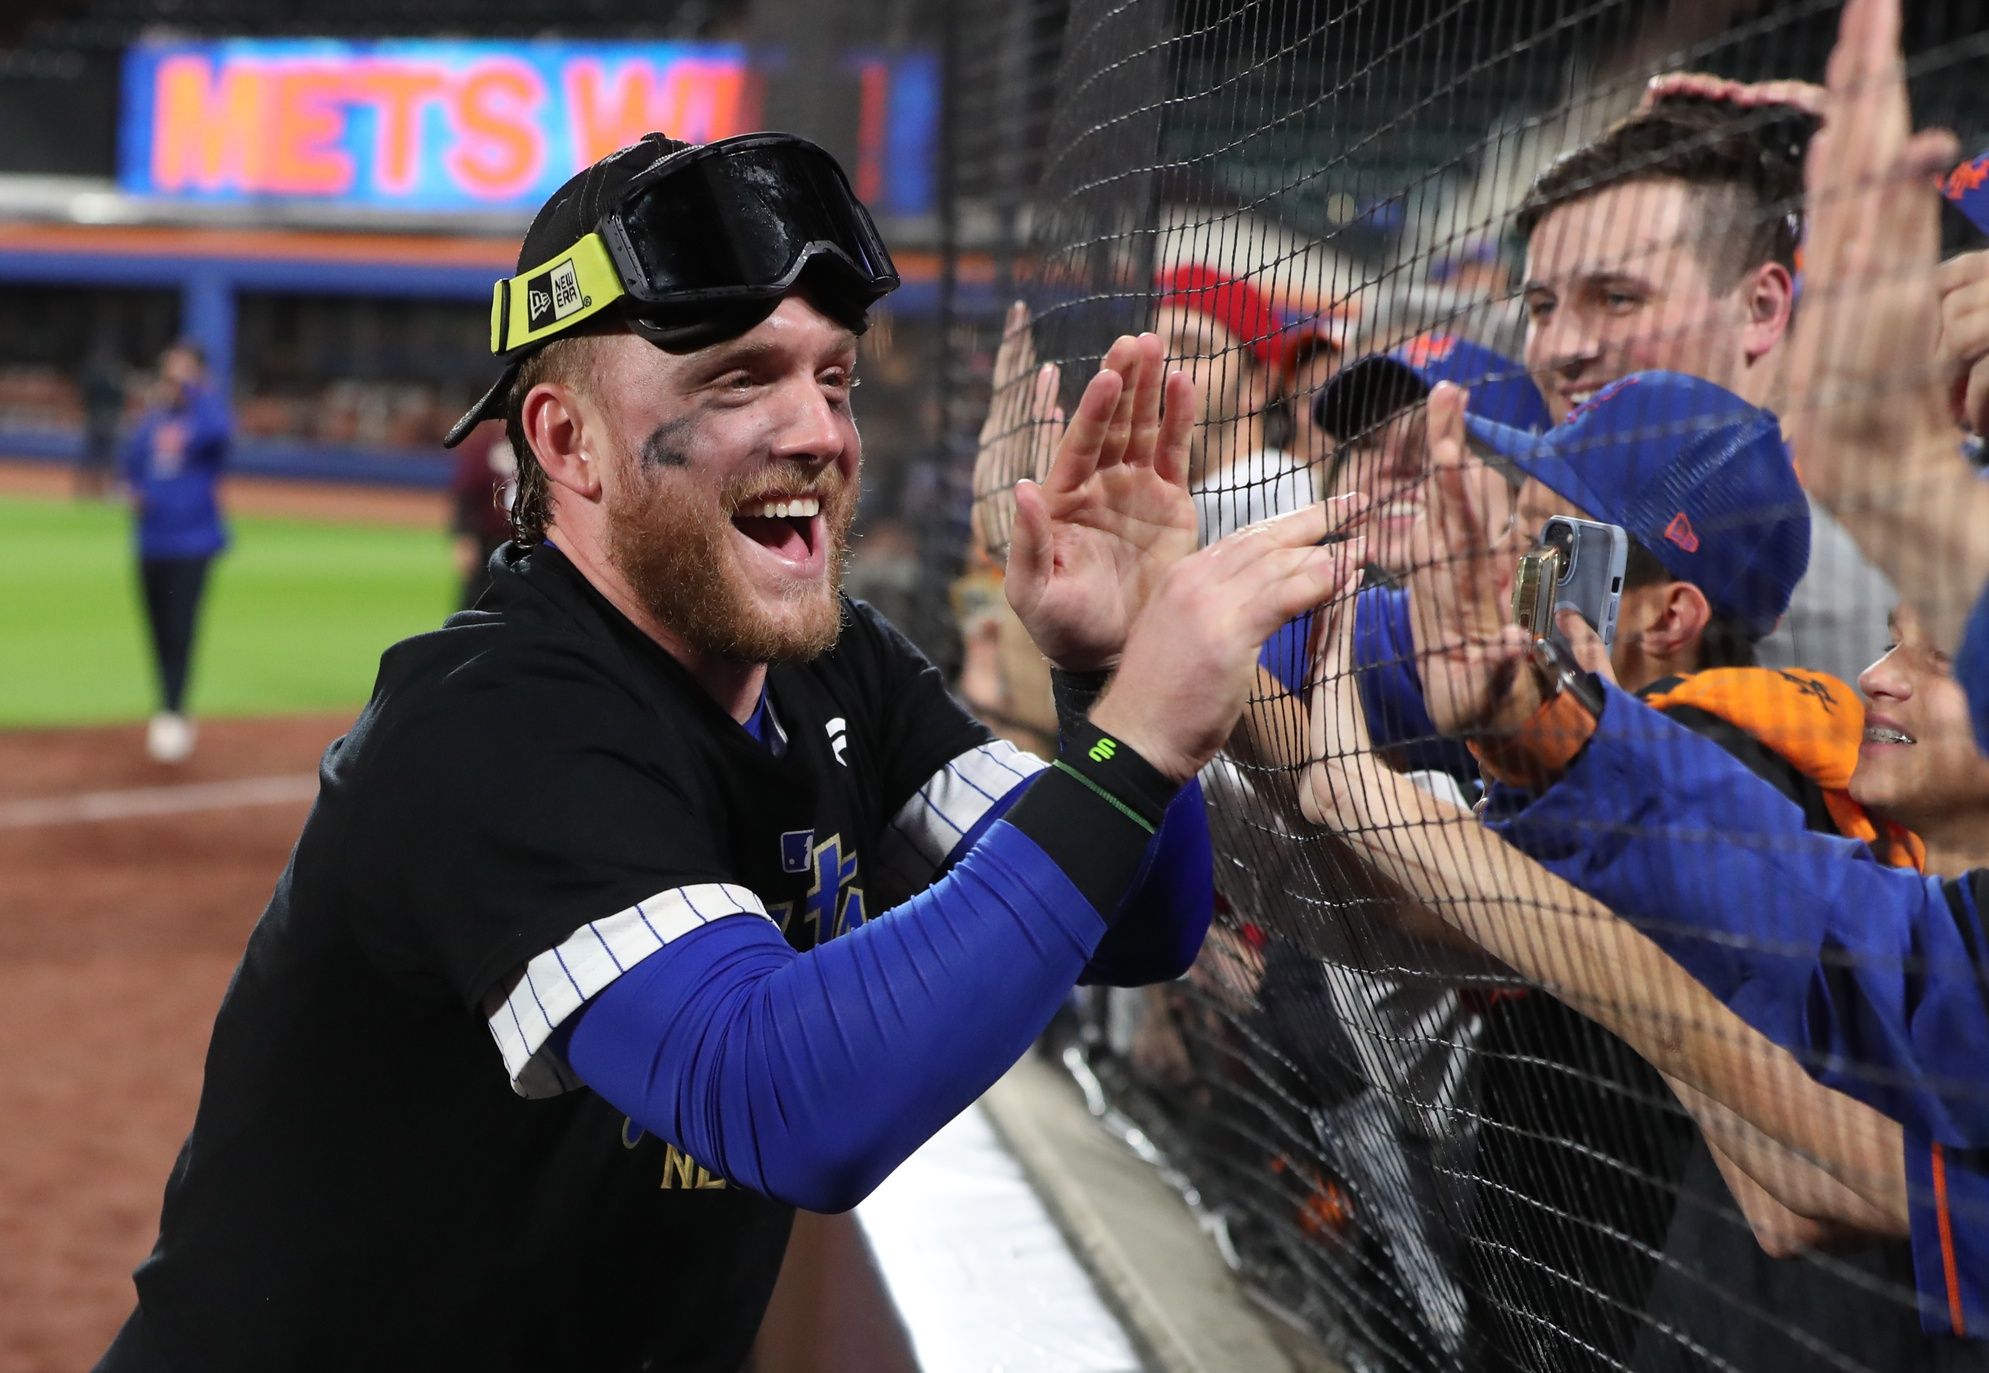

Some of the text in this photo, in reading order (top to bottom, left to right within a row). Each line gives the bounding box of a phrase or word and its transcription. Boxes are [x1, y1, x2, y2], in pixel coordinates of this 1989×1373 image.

[153, 55, 545, 197] METS
[555, 271, 574, 292] NEW
[556, 286, 578, 308] ERA
